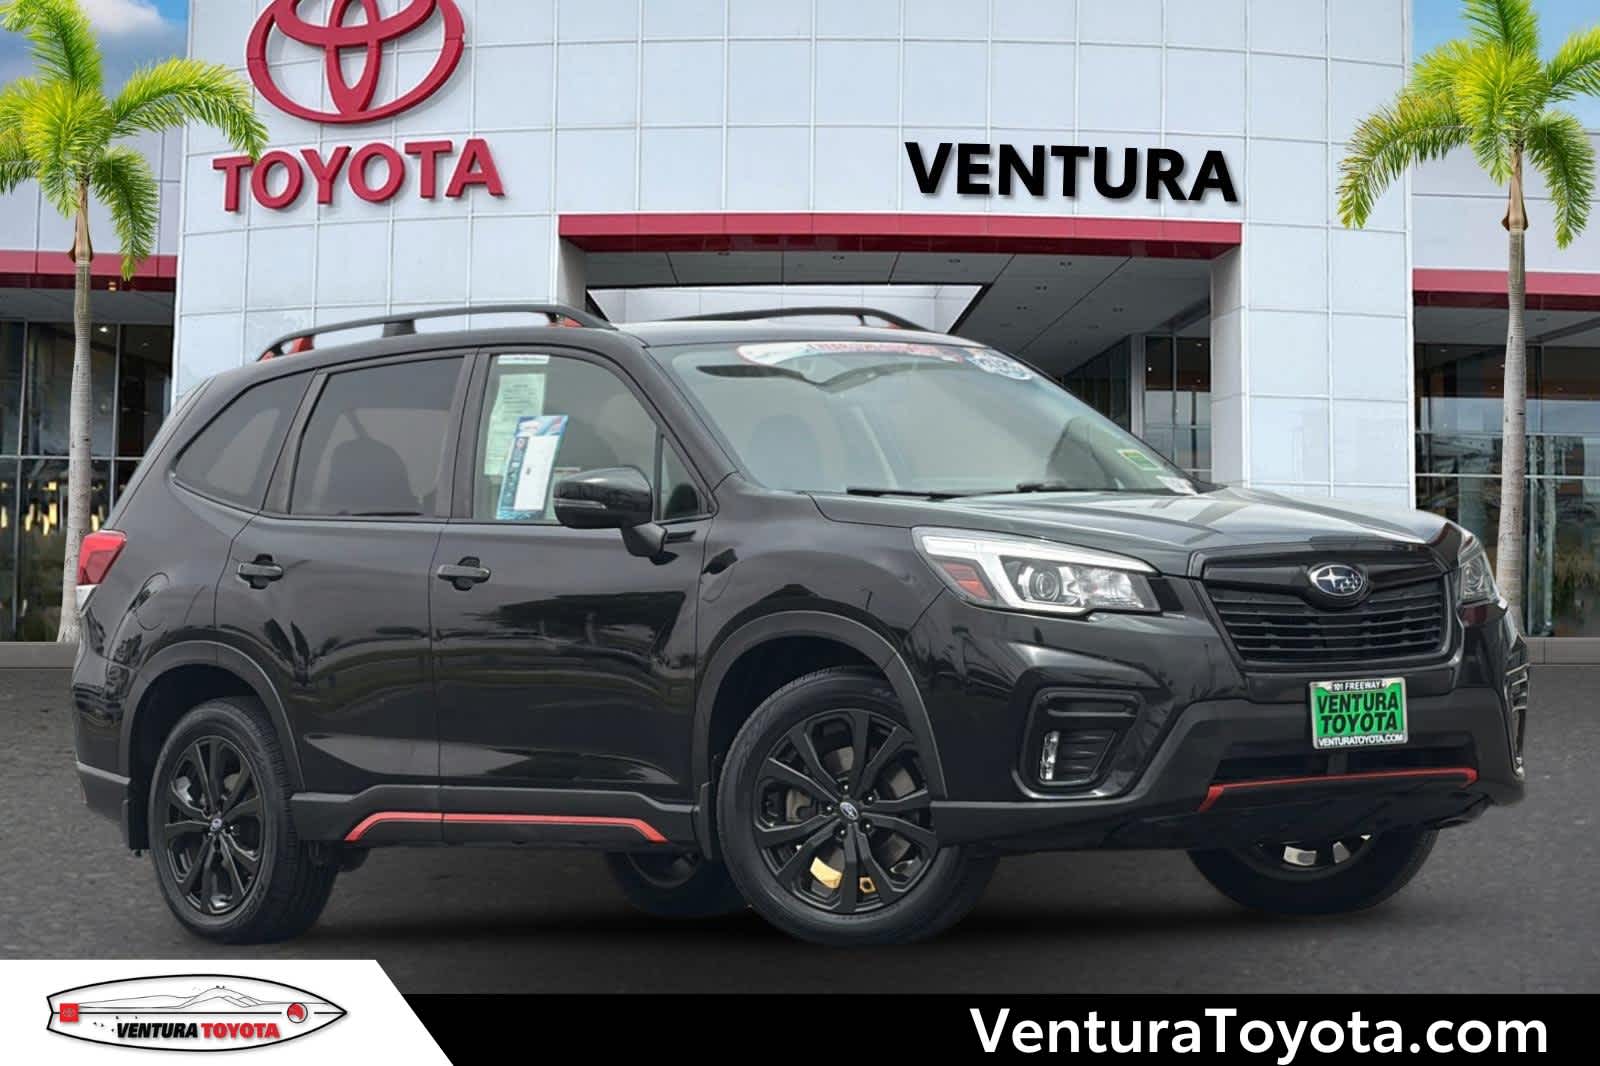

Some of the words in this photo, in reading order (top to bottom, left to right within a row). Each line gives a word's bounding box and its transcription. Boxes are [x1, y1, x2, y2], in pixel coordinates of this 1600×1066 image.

[212, 138, 504, 212] TOYOTA
[904, 141, 1238, 203] VENTURA
[1333, 683, 1344, 691] 101
[1345, 681, 1381, 690] FREEWAY
[1317, 692, 1399, 714] VENTURA
[1320, 712, 1398, 734] TOYOTA
[1318, 734, 1403, 746] VENTURATOYOTA.COM
